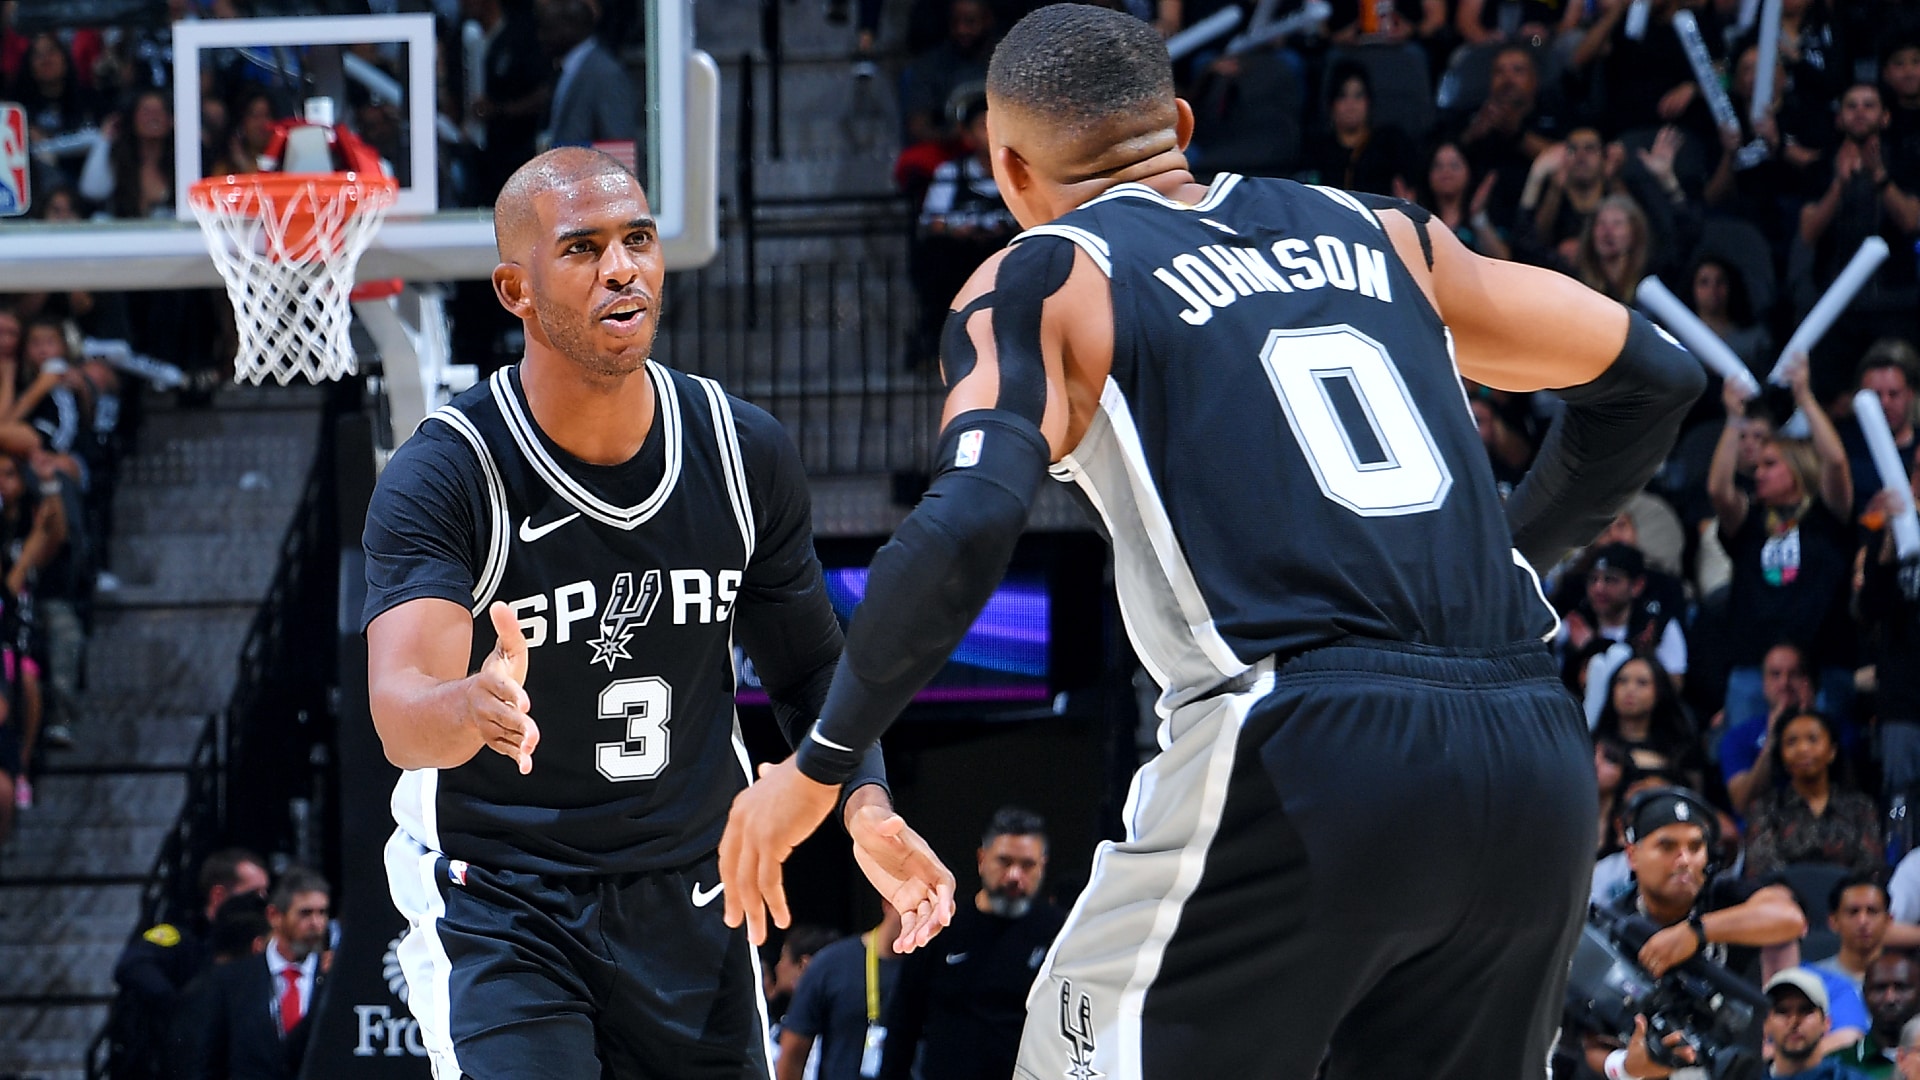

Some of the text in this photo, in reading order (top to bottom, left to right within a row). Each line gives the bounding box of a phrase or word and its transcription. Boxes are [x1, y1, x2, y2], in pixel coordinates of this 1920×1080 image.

[1153, 235, 1392, 325] JOHNSON
[1258, 323, 1453, 517] 0
[508, 569, 743, 672] SPURS
[595, 675, 672, 782] 3
